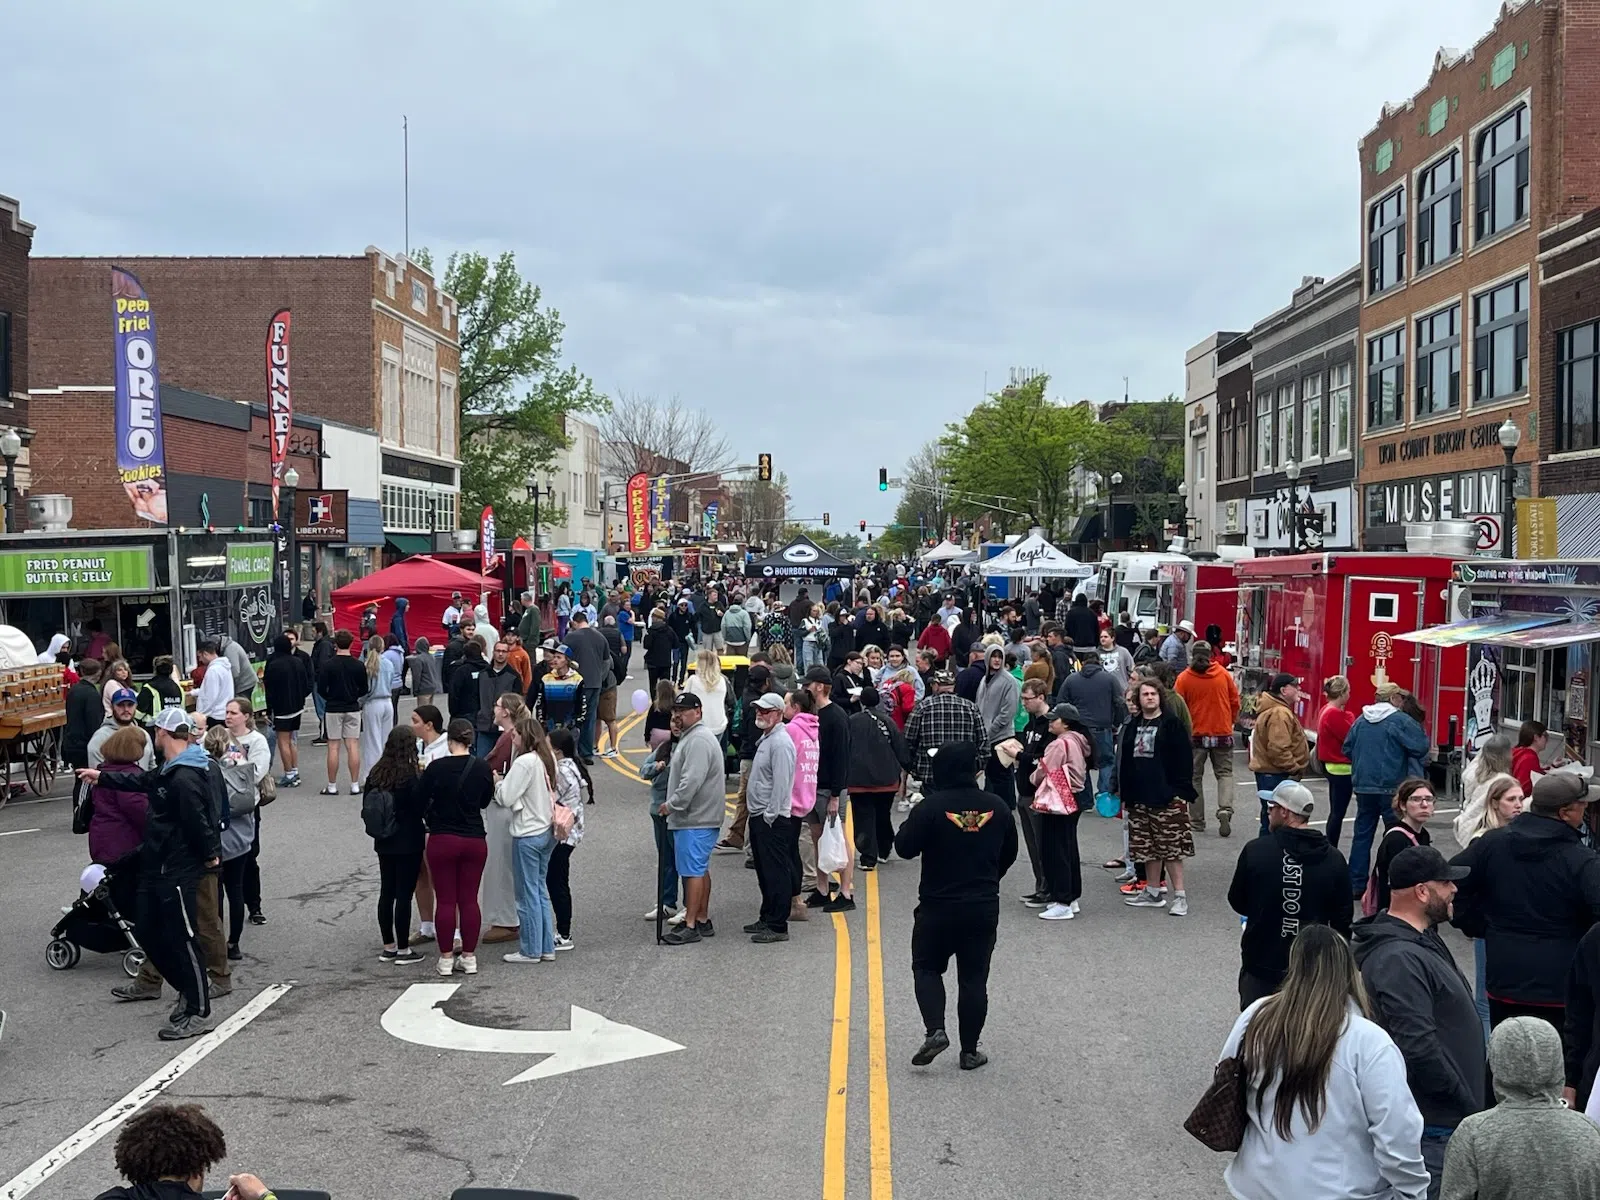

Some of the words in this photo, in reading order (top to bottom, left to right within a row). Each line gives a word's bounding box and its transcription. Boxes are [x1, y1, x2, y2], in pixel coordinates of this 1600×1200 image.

[126, 339, 156, 459] OREO
[1379, 442, 1396, 465] LYON
[1400, 436, 1430, 461] COUNTY
[1434, 428, 1466, 455] HISTORY
[1385, 474, 1497, 523] MUSEUM
[631, 489, 646, 549] PRETZELS
[1530, 529, 1539, 558] PORIA
[26, 573, 69, 584] BUTTER
[72, 573, 79, 583] &
[82, 571, 113, 582] JELLY
[27, 559, 59, 571] FRIED
[62, 558, 106, 570] PEANUT
[230, 557, 252, 573] FUNNEL
[774, 567, 807, 576] BOURBON
[808, 567, 838, 576] COWBOY
[1282, 849, 1304, 885] UST
[1282, 888, 1301, 915] DO
[1280, 917, 1300, 938] IT.
